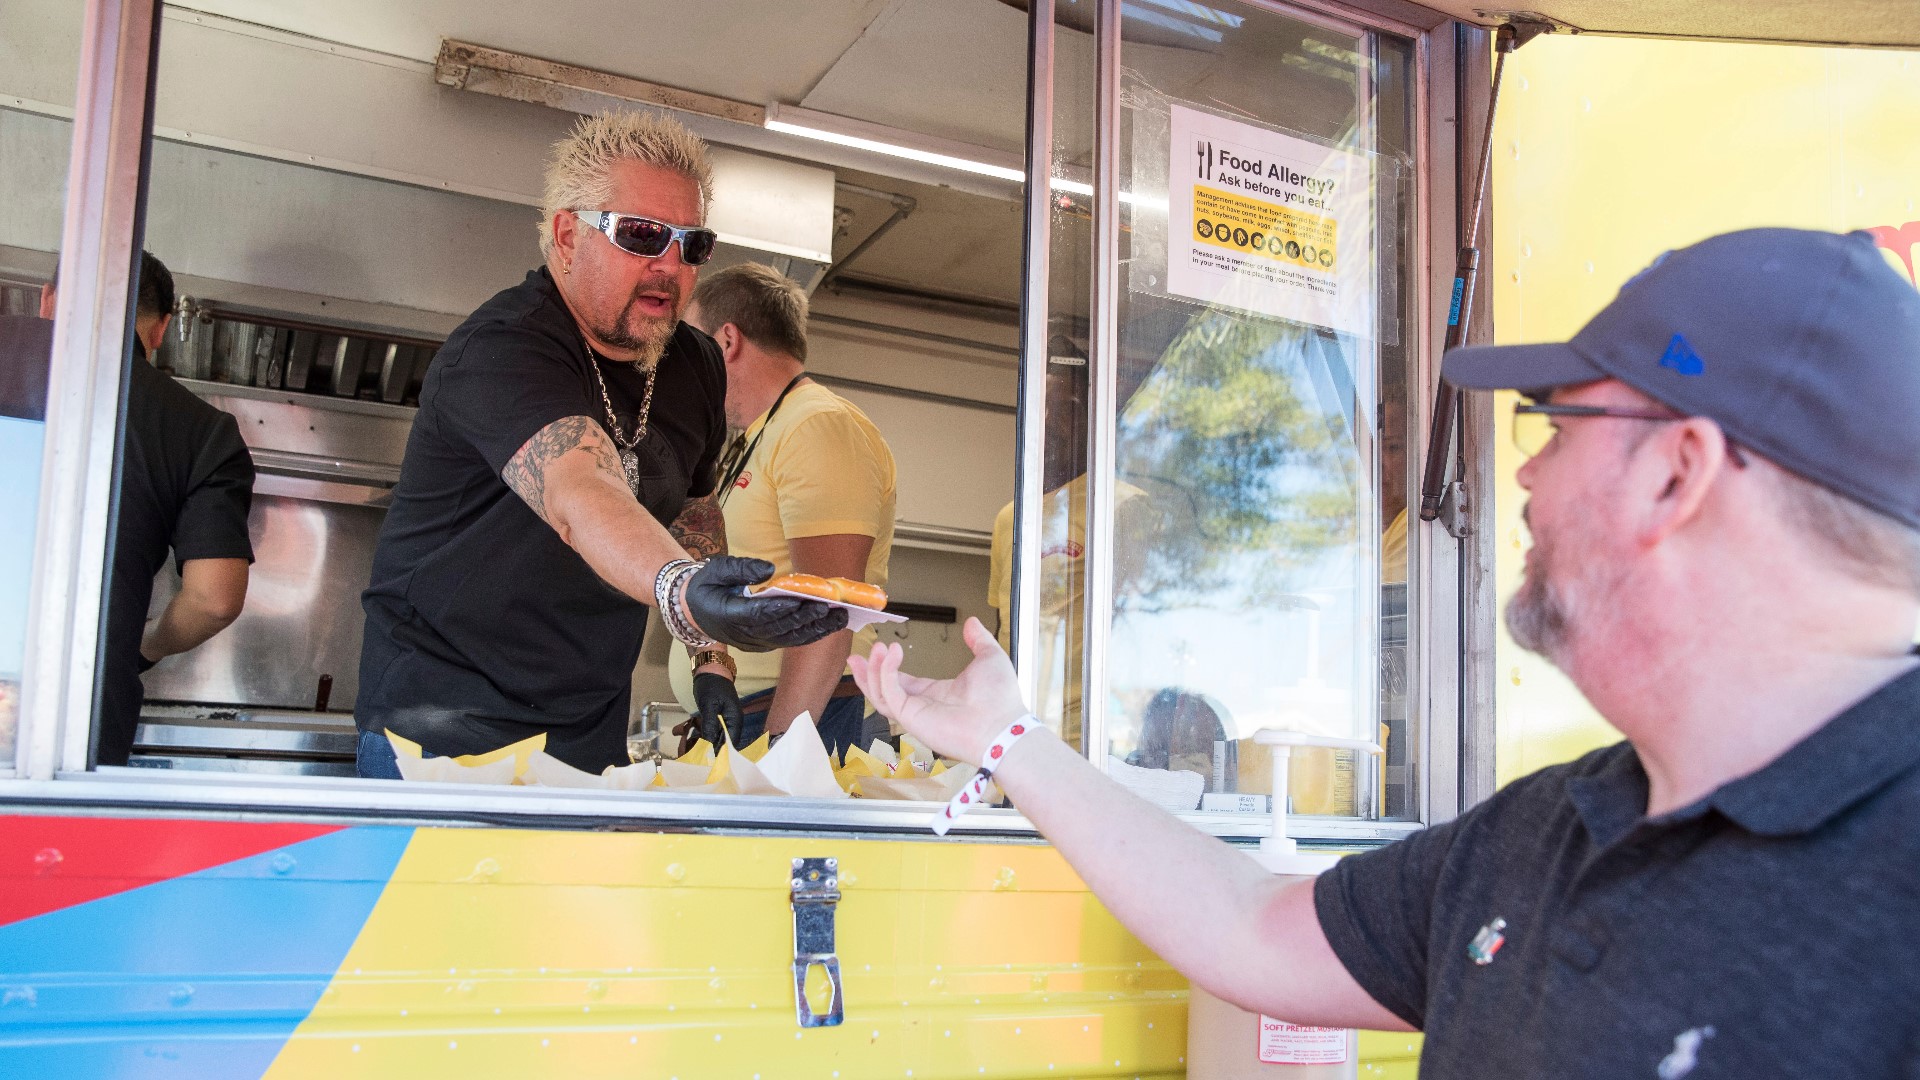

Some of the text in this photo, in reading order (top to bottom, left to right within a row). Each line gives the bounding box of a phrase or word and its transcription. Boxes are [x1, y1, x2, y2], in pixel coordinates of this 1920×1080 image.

[1220, 150, 1335, 196] Food Allergy?
[1196, 190, 1234, 204] Management
[1219, 172, 1241, 188] Ask
[1244, 178, 1281, 198] before
[1284, 191, 1304, 205] you
[1196, 200, 1218, 208] contain
[1226, 206, 1240, 214] have
[1242, 210, 1257, 218] come
[1192, 248, 1214, 258] Please
[1231, 258, 1256, 268] member
[1278, 270, 1295, 278] about
[1216, 262, 1230, 270] meal
[1252, 271, 1274, 283] placing
[1307, 283, 1325, 292] Thank
[1264, 1024, 1284, 1032] SOFT
[1286, 1024, 1316, 1032] PRETZEL
